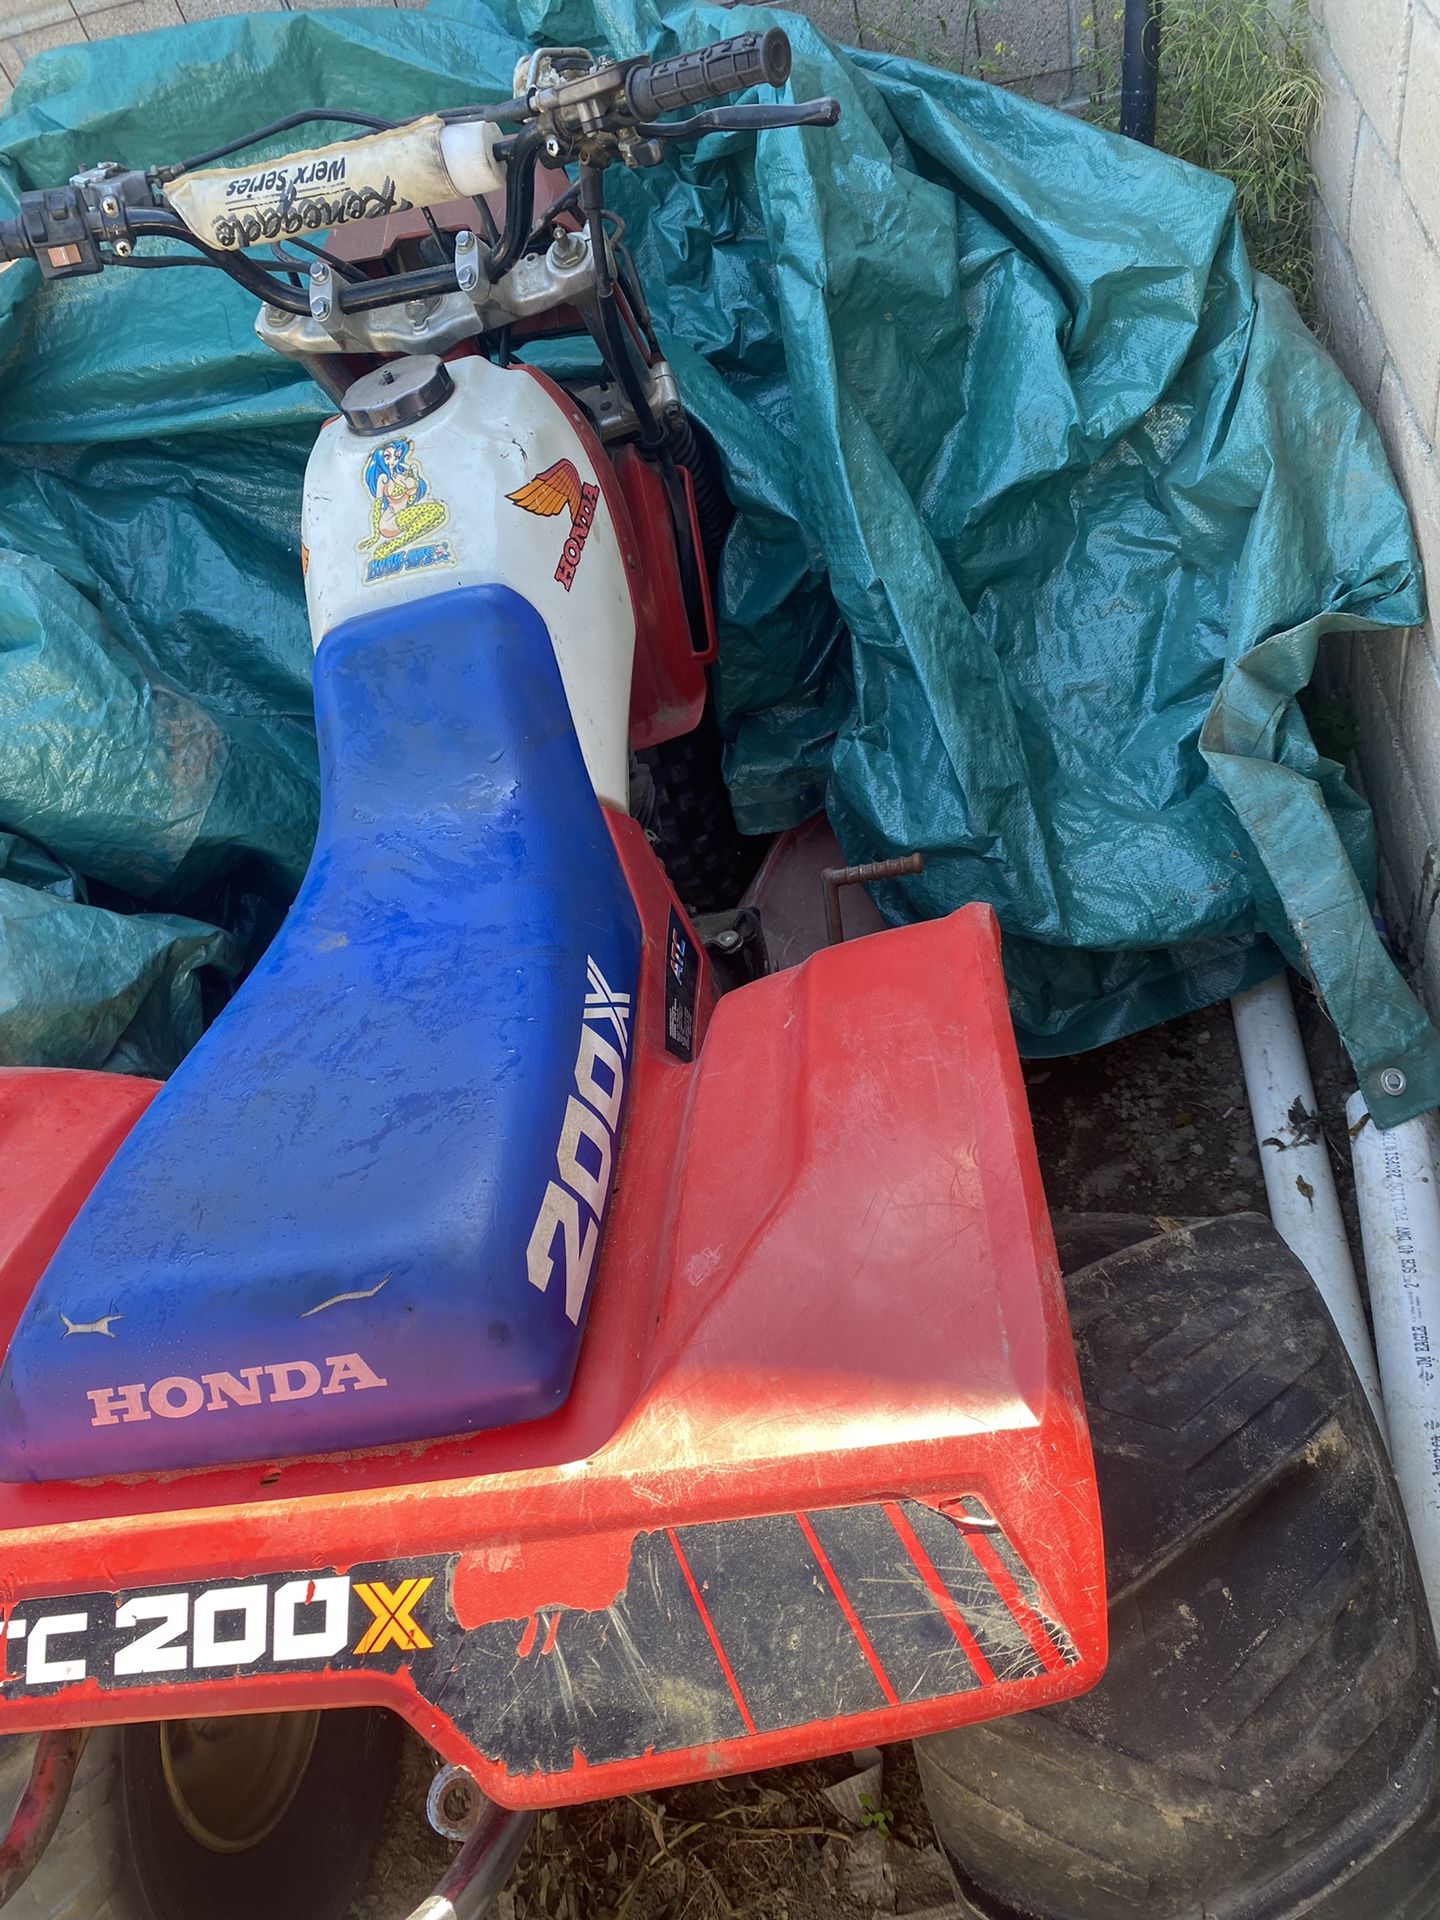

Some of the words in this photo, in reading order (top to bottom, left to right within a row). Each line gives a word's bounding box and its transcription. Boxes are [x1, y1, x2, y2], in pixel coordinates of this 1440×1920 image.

[225, 168, 288, 199] Series
[293, 156, 346, 187] Werx
[211, 176, 413, 248] Renegade
[554, 481, 600, 592] HONDA
[669, 927, 687, 986] ATC
[525, 954, 631, 1327] 200X
[1397, 1244, 1414, 1255] 40
[1411, 1325, 1430, 1352] EAGLE
[86, 1352, 388, 1427] HONDA
